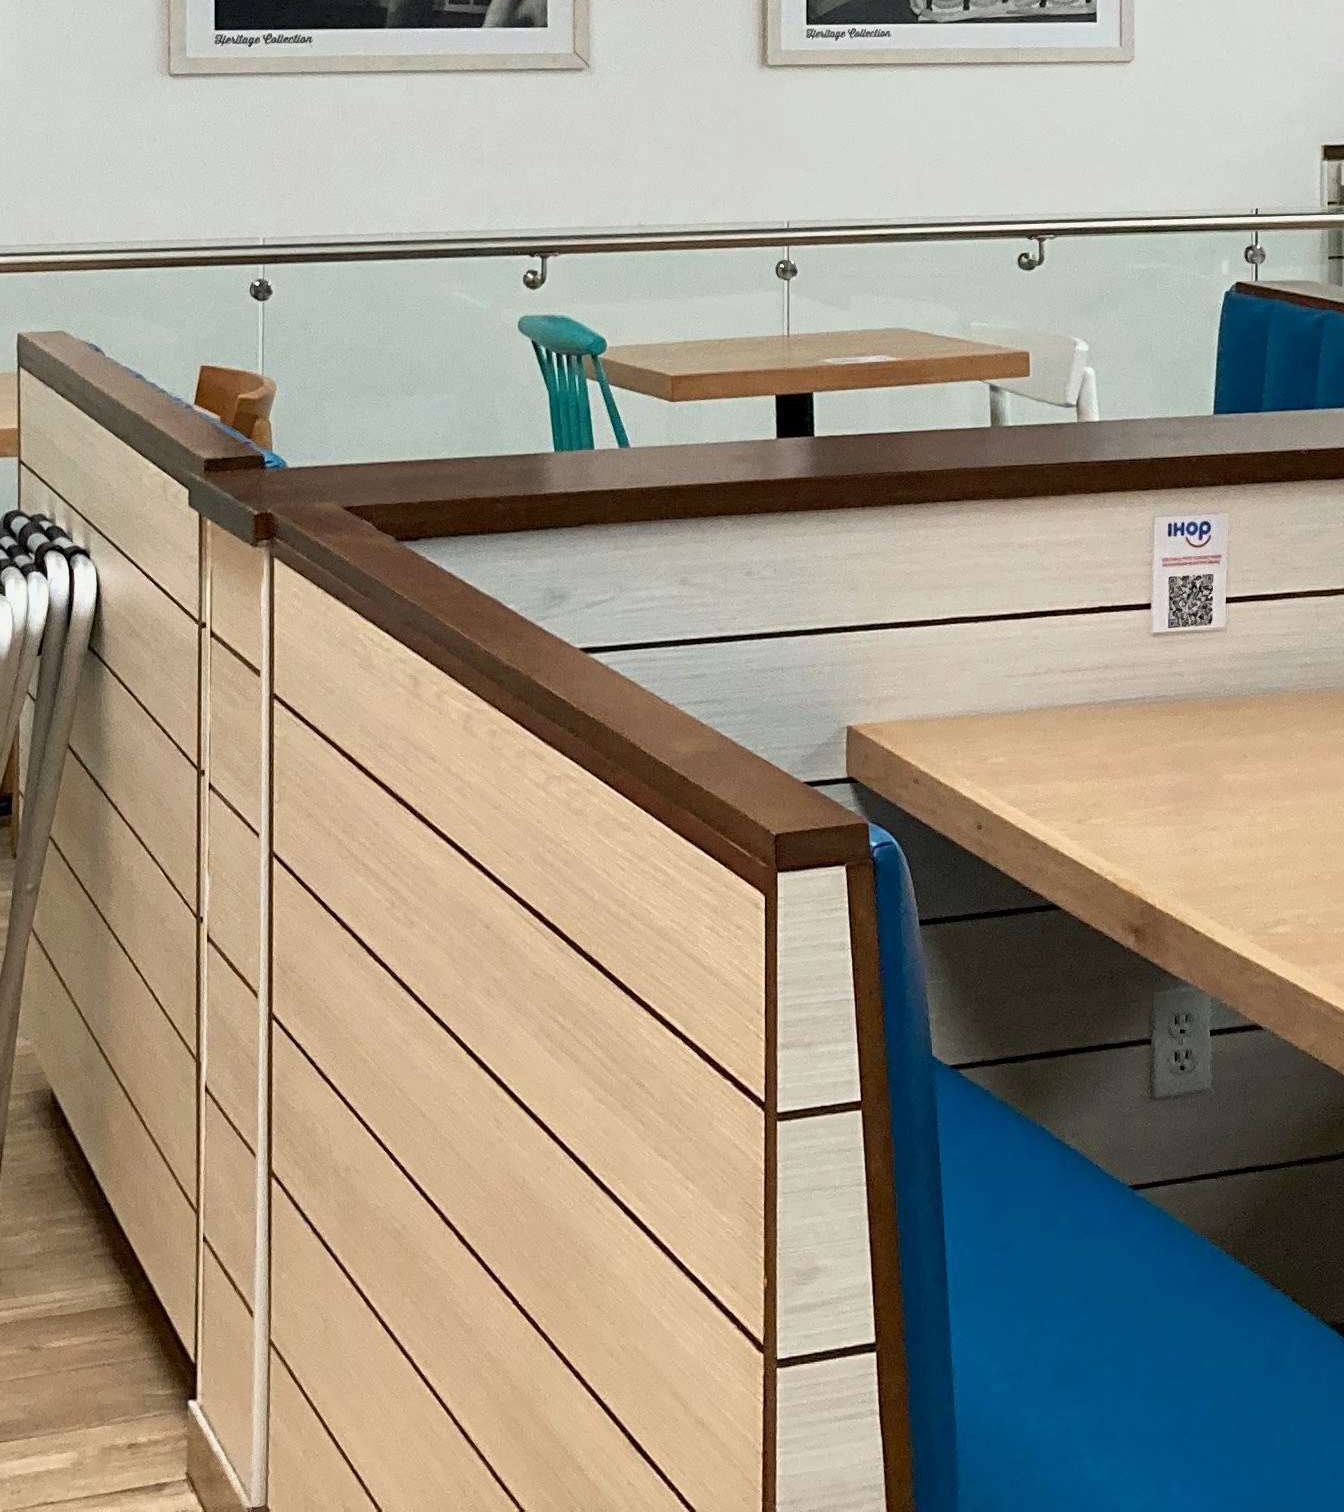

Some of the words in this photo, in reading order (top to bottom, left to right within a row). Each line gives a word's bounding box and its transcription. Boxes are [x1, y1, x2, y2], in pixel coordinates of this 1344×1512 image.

[214, 33, 261, 48] Heritage
[263, 32, 314, 45] Collection
[805, 28, 846, 42] Heritage
[847, 27, 892, 39] Collection
[1167, 520, 1212, 541] IHOP
